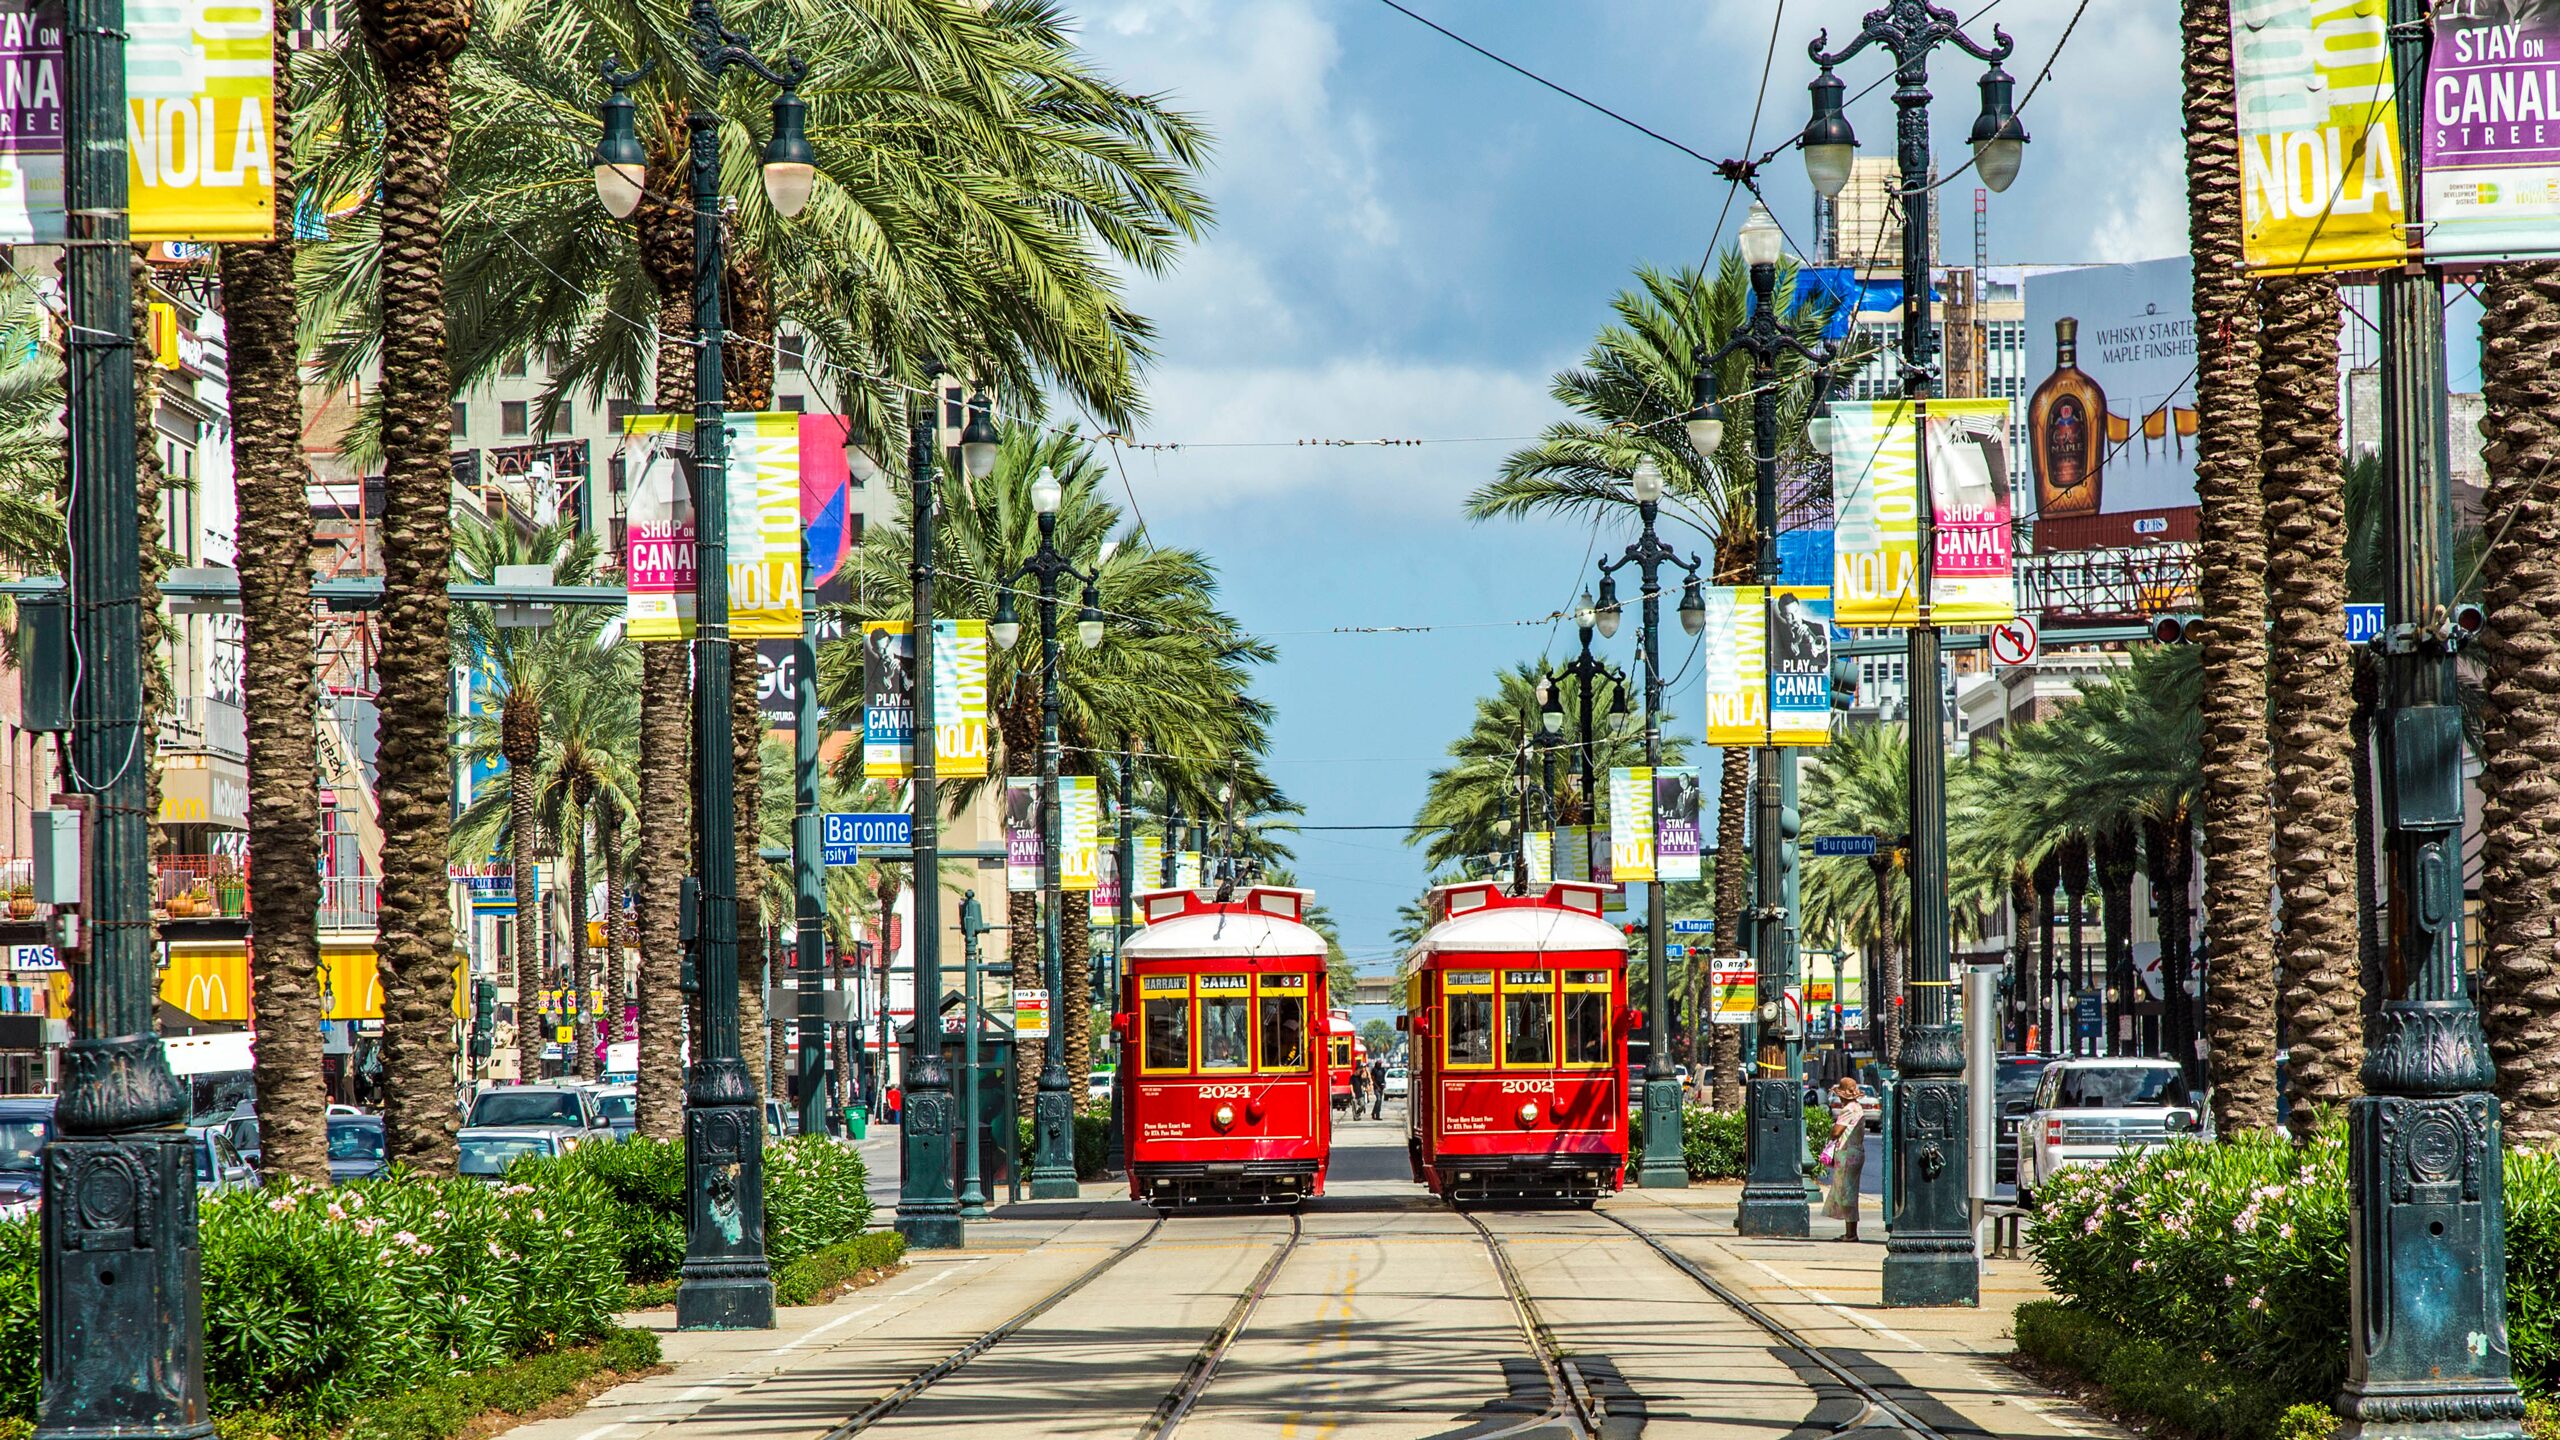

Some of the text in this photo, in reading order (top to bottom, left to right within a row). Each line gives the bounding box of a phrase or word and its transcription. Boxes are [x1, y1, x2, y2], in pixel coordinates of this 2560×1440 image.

[40, 28, 60, 46] ON
[2455, 23, 2544, 63] STAY ON
[2435, 70, 2560, 125] CANAL
[128, 97, 272, 188] NOLA
[2437, 125, 2545, 148] STREE
[2244, 122, 2403, 221] NOLA
[2097, 319, 2194, 346] WHISKY STARTE
[2102, 339, 2197, 364] MAPLE FINISHED
[1943, 503, 1995, 522] SHOP ON
[641, 520, 682, 538] SHOP
[1937, 527, 2005, 554] CANAL
[1937, 555, 2005, 566] STREET
[633, 572, 693, 582] STREE
[1836, 551, 1917, 600] NOLA
[728, 562, 800, 610] NOLA
[1783, 659, 1819, 673] PLAY ON
[1775, 676, 1827, 696] CANAL
[876, 693, 902, 706] PLAY
[1776, 695, 1826, 704] STREET
[767, 710, 795, 721] SATURD
[1707, 693, 1766, 727] NOLA
[935, 724, 987, 758] NOLA
[828, 817, 909, 842] Baronne
[1666, 819, 1684, 829] STAY
[1016, 829, 1034, 839] STAY
[1660, 831, 1697, 846] CANAL
[1011, 842, 1045, 856] CANAL
[1822, 838, 1874, 853] Burgundy
[1061, 852, 1097, 877] NOLA
[1612, 843, 1654, 868] NOLA
[449, 863, 513, 877] HOLLWOOD
[1686, 920, 1713, 932] Rampart
[18, 947, 60, 967] FAS
[1144, 977, 1187, 990] HARRAH'S
[1200, 976, 1246, 988] CANAL
[1511, 972, 1545, 983] RTA
[1198, 1086, 1251, 1099] 2024
[1502, 1080, 1555, 1094] 2002
